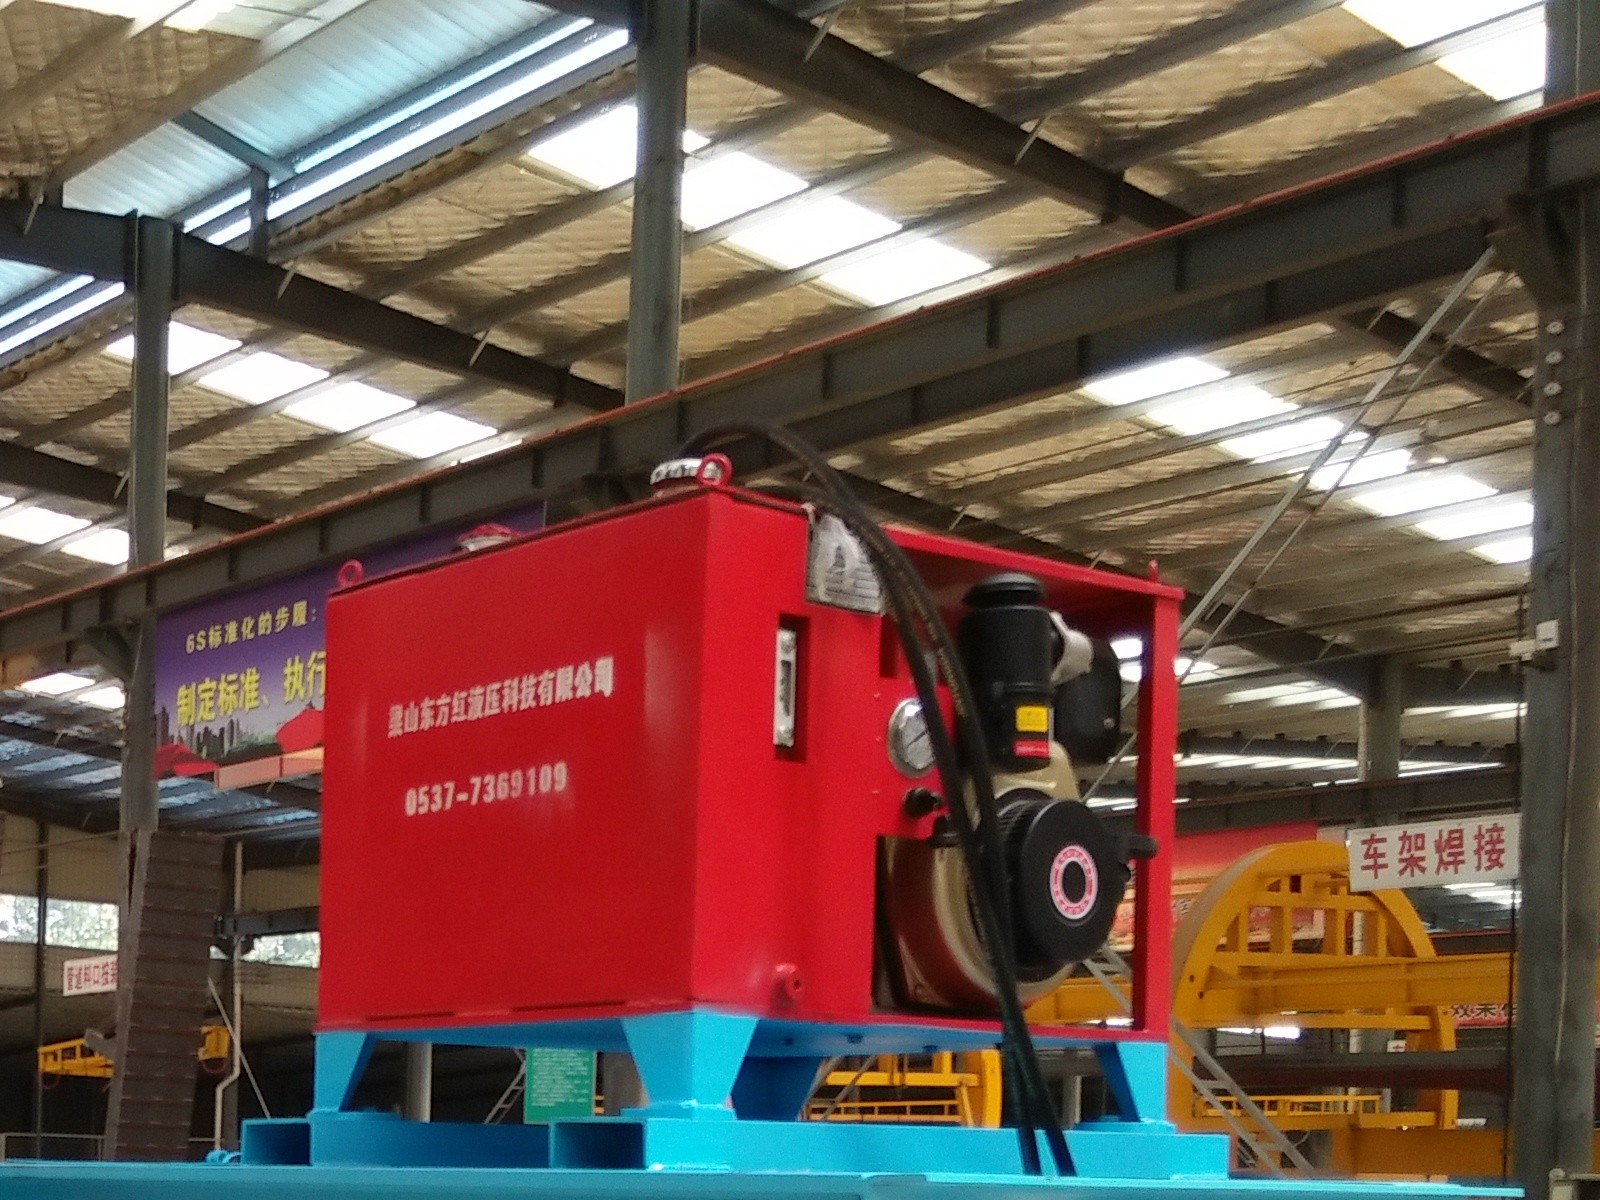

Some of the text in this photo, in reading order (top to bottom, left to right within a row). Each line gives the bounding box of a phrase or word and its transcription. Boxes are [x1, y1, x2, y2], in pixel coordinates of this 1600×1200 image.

[404, 760, 568, 817] 0537-7369109
[1360, 822, 1506, 880] 车架焊接
